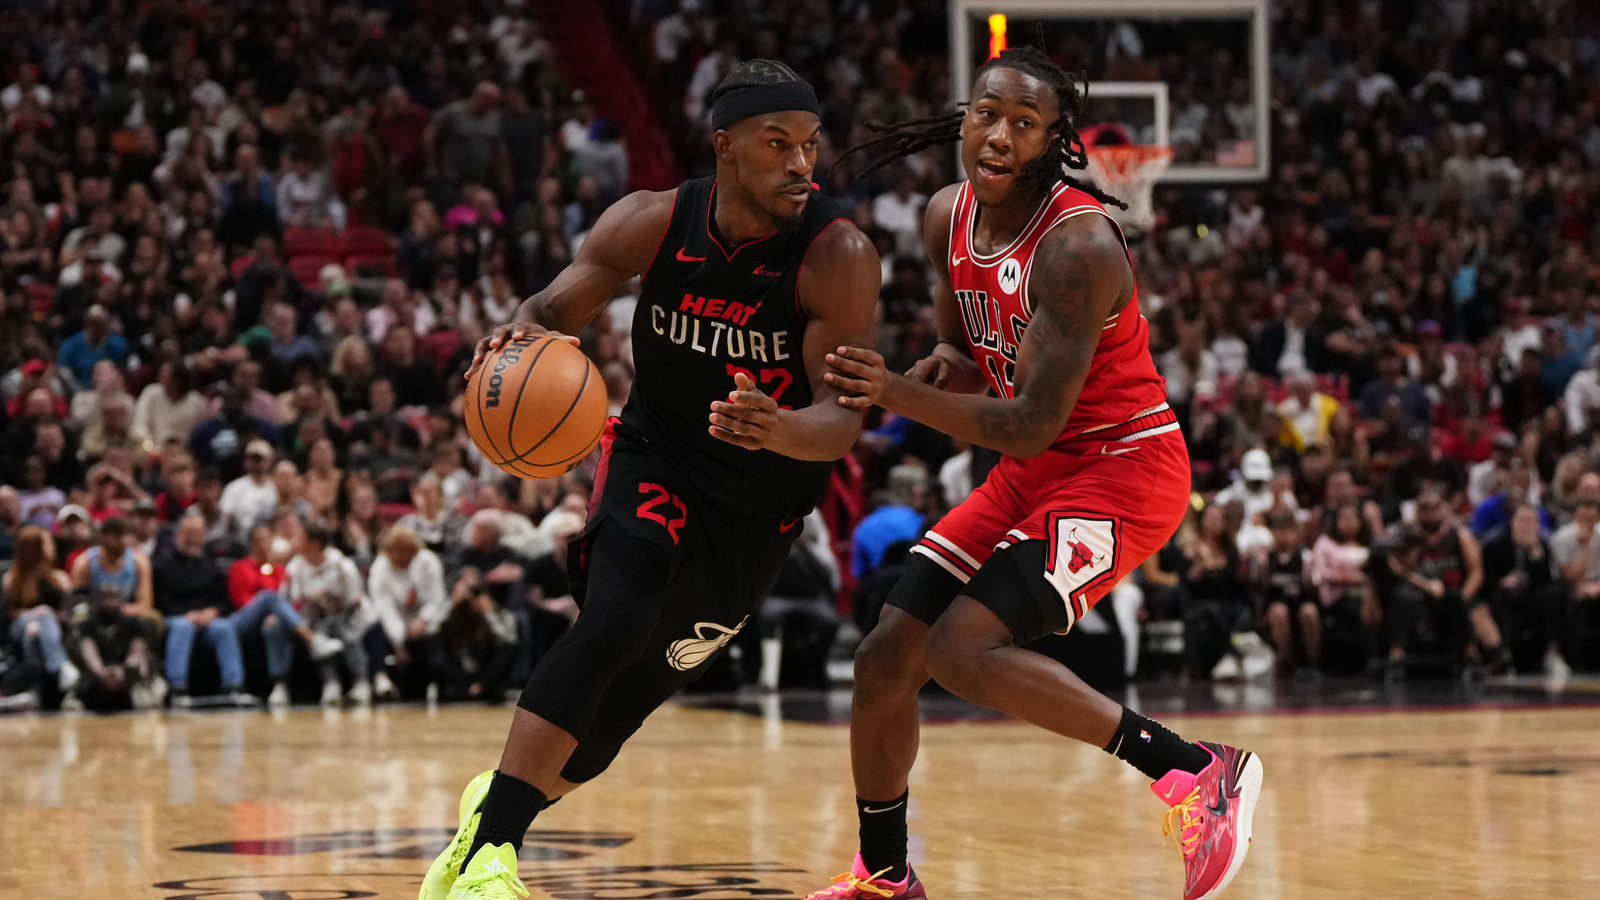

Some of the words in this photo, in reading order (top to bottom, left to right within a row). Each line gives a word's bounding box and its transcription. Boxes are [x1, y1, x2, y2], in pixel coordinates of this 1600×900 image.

[651, 304, 789, 362] CULTURE
[679, 293, 762, 326] HEAT
[637, 482, 687, 546] 22
